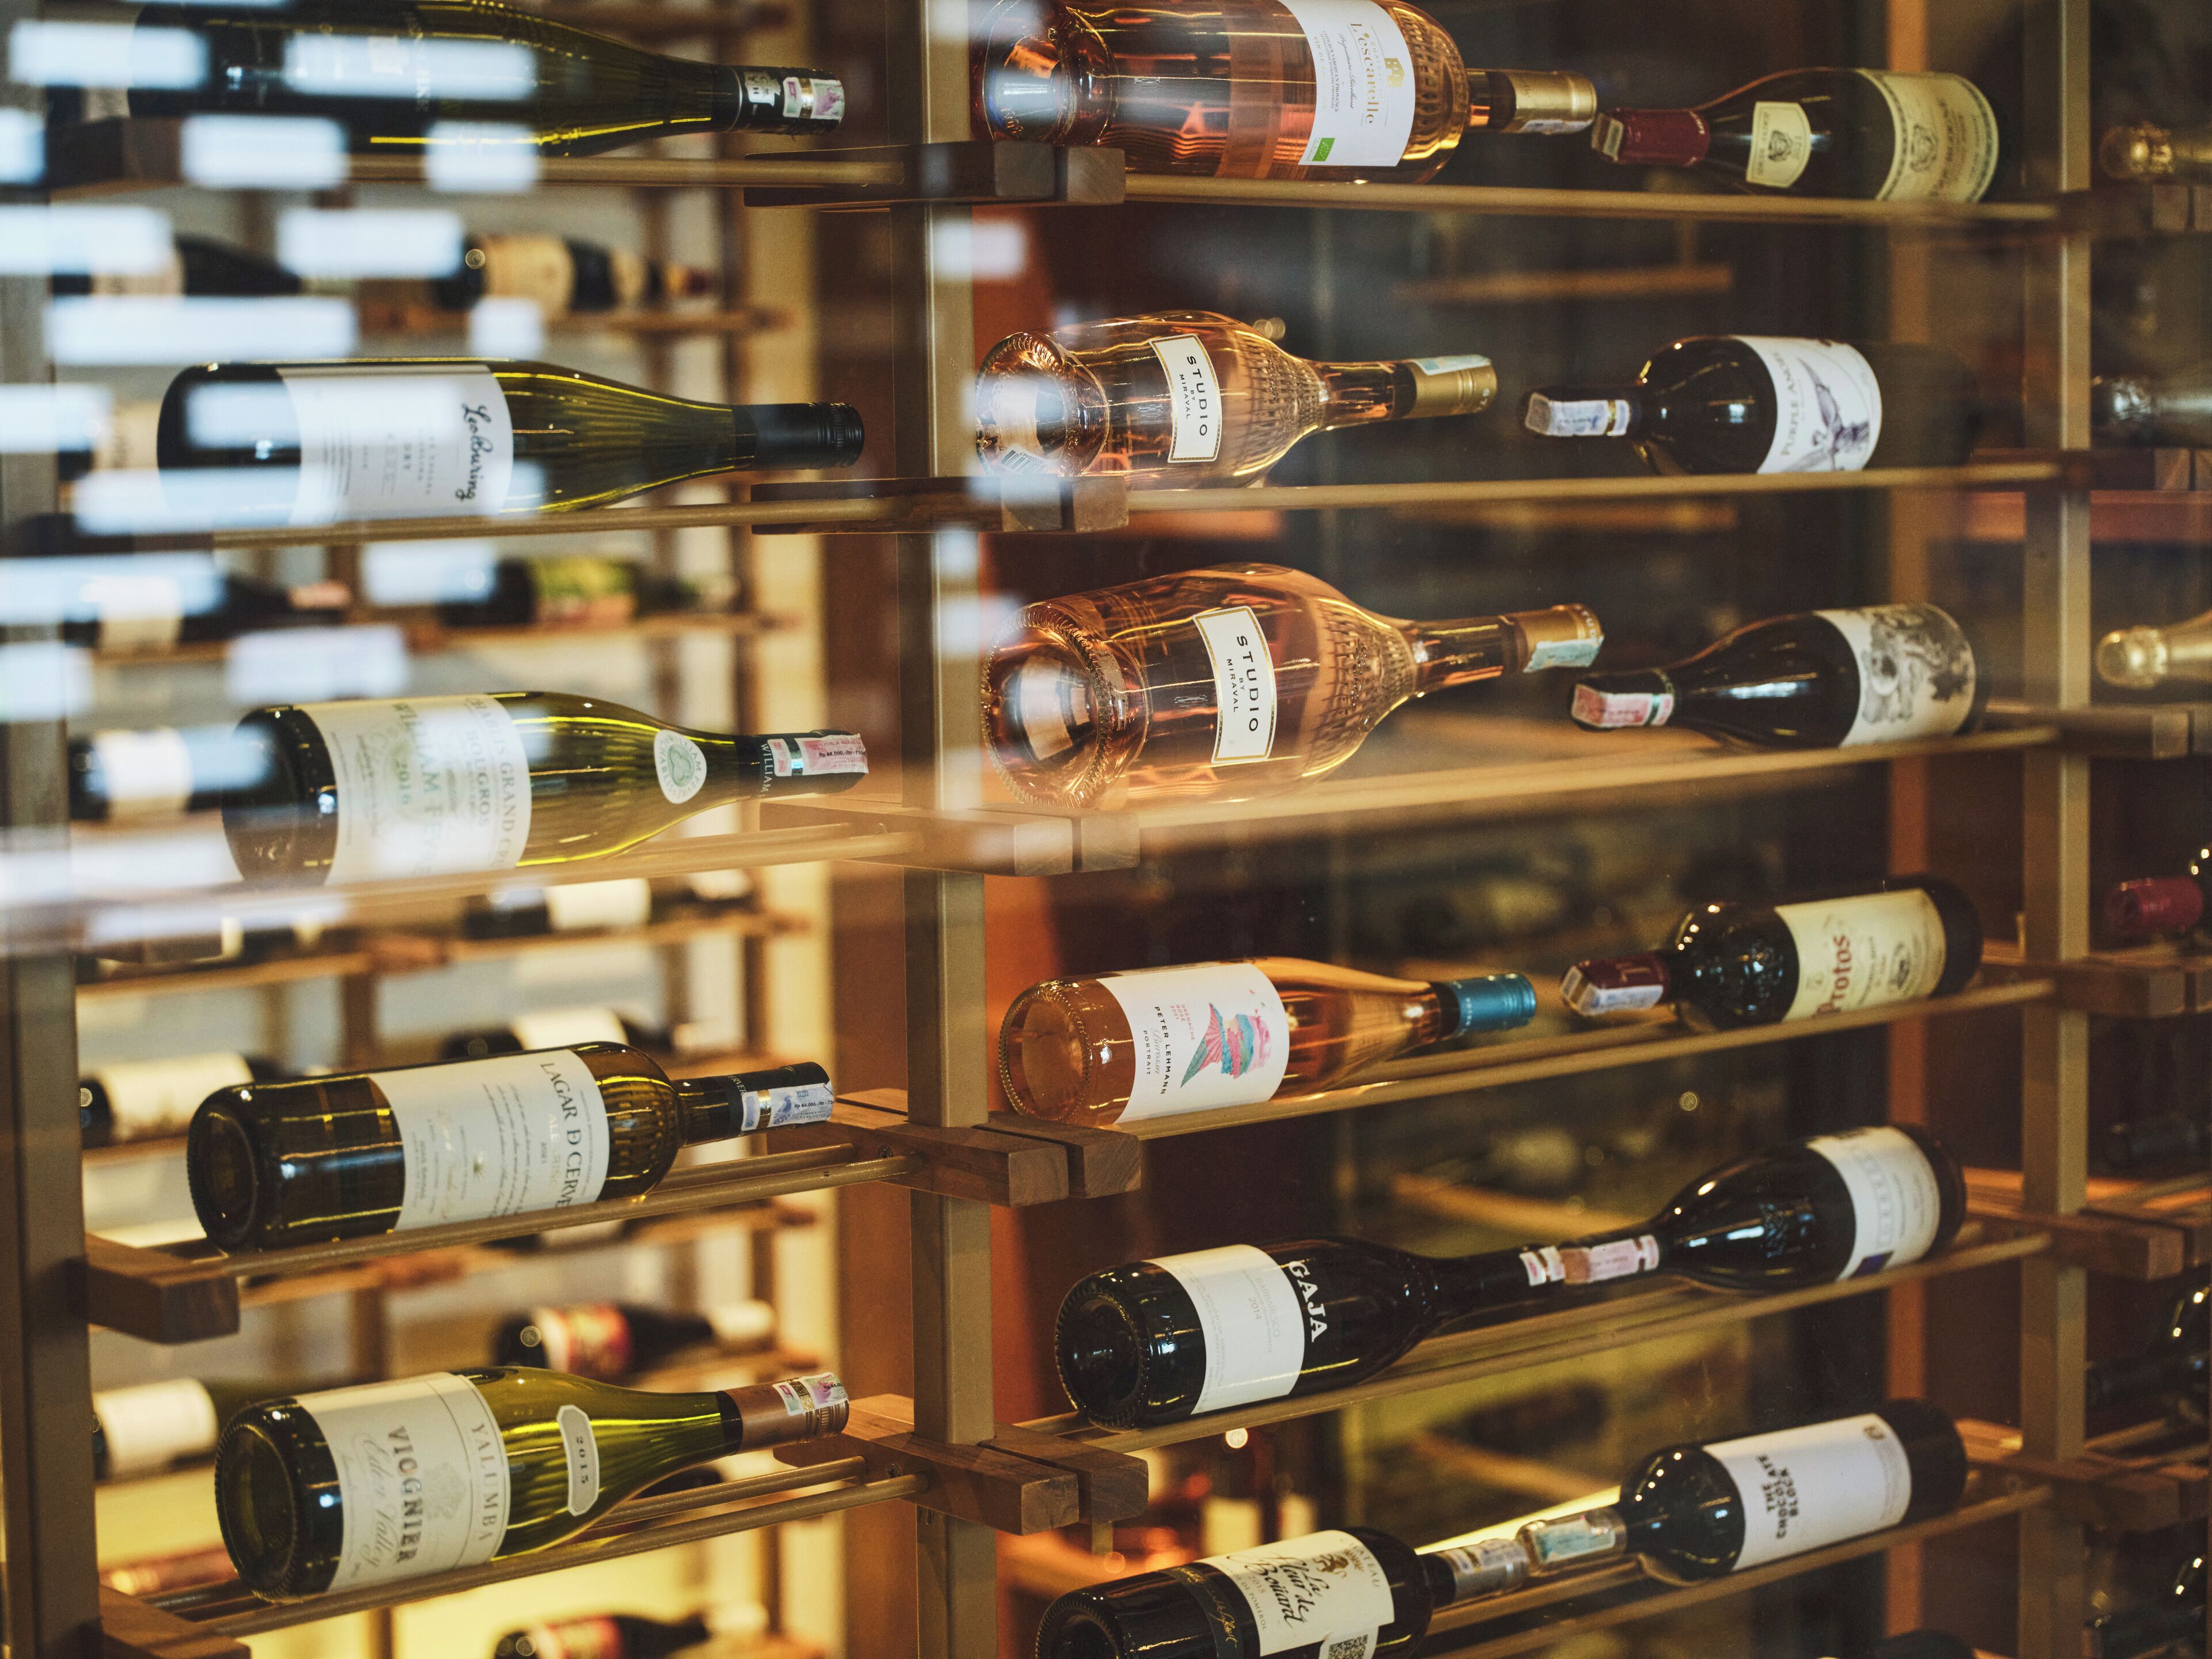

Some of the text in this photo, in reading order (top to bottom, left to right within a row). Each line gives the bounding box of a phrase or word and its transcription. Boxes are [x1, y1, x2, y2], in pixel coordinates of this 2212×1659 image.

[1350, 22, 1379, 125] L'escarelle
[1179, 374, 1191, 419] MIRAVAL
[1187, 355, 1208, 436] STUDIO
[1190, 389, 1196, 401] BY
[1226, 658, 1238, 713] MIRAVAL
[1237, 635, 1259, 732] STUDIO
[1239, 677, 1245, 691] BY
[465, 730, 492, 827] BOUGROS
[760, 743, 775, 793] WILLIAM
[499, 762, 517, 832] GRAND
[1816, 934, 1852, 1014] Protos
[1171, 1005, 1179, 1020] 2021
[1181, 1004, 1195, 1041] GRENACHE
[1154, 1006, 1171, 1094] PETER LEHMANN
[541, 1063, 578, 1121] LAGAR
[1248, 1298, 1262, 1320] 2014
[1255, 1278, 1281, 1338] BARBARESCO
[1288, 1260, 1328, 1343] GAJA
[472, 1423, 499, 1541] YALUMBA
[576, 1435, 589, 1484] 2015
[388, 1425, 423, 1563] VIOGNIER
[1756, 1455, 1787, 1539] CHOCOLATE
[1761, 1483, 1775, 1513] THE
[1779, 1467, 1799, 1517] BLOCK
[1248, 1592, 1267, 1630] POMEROL
[1294, 1594, 1315, 1623] de
